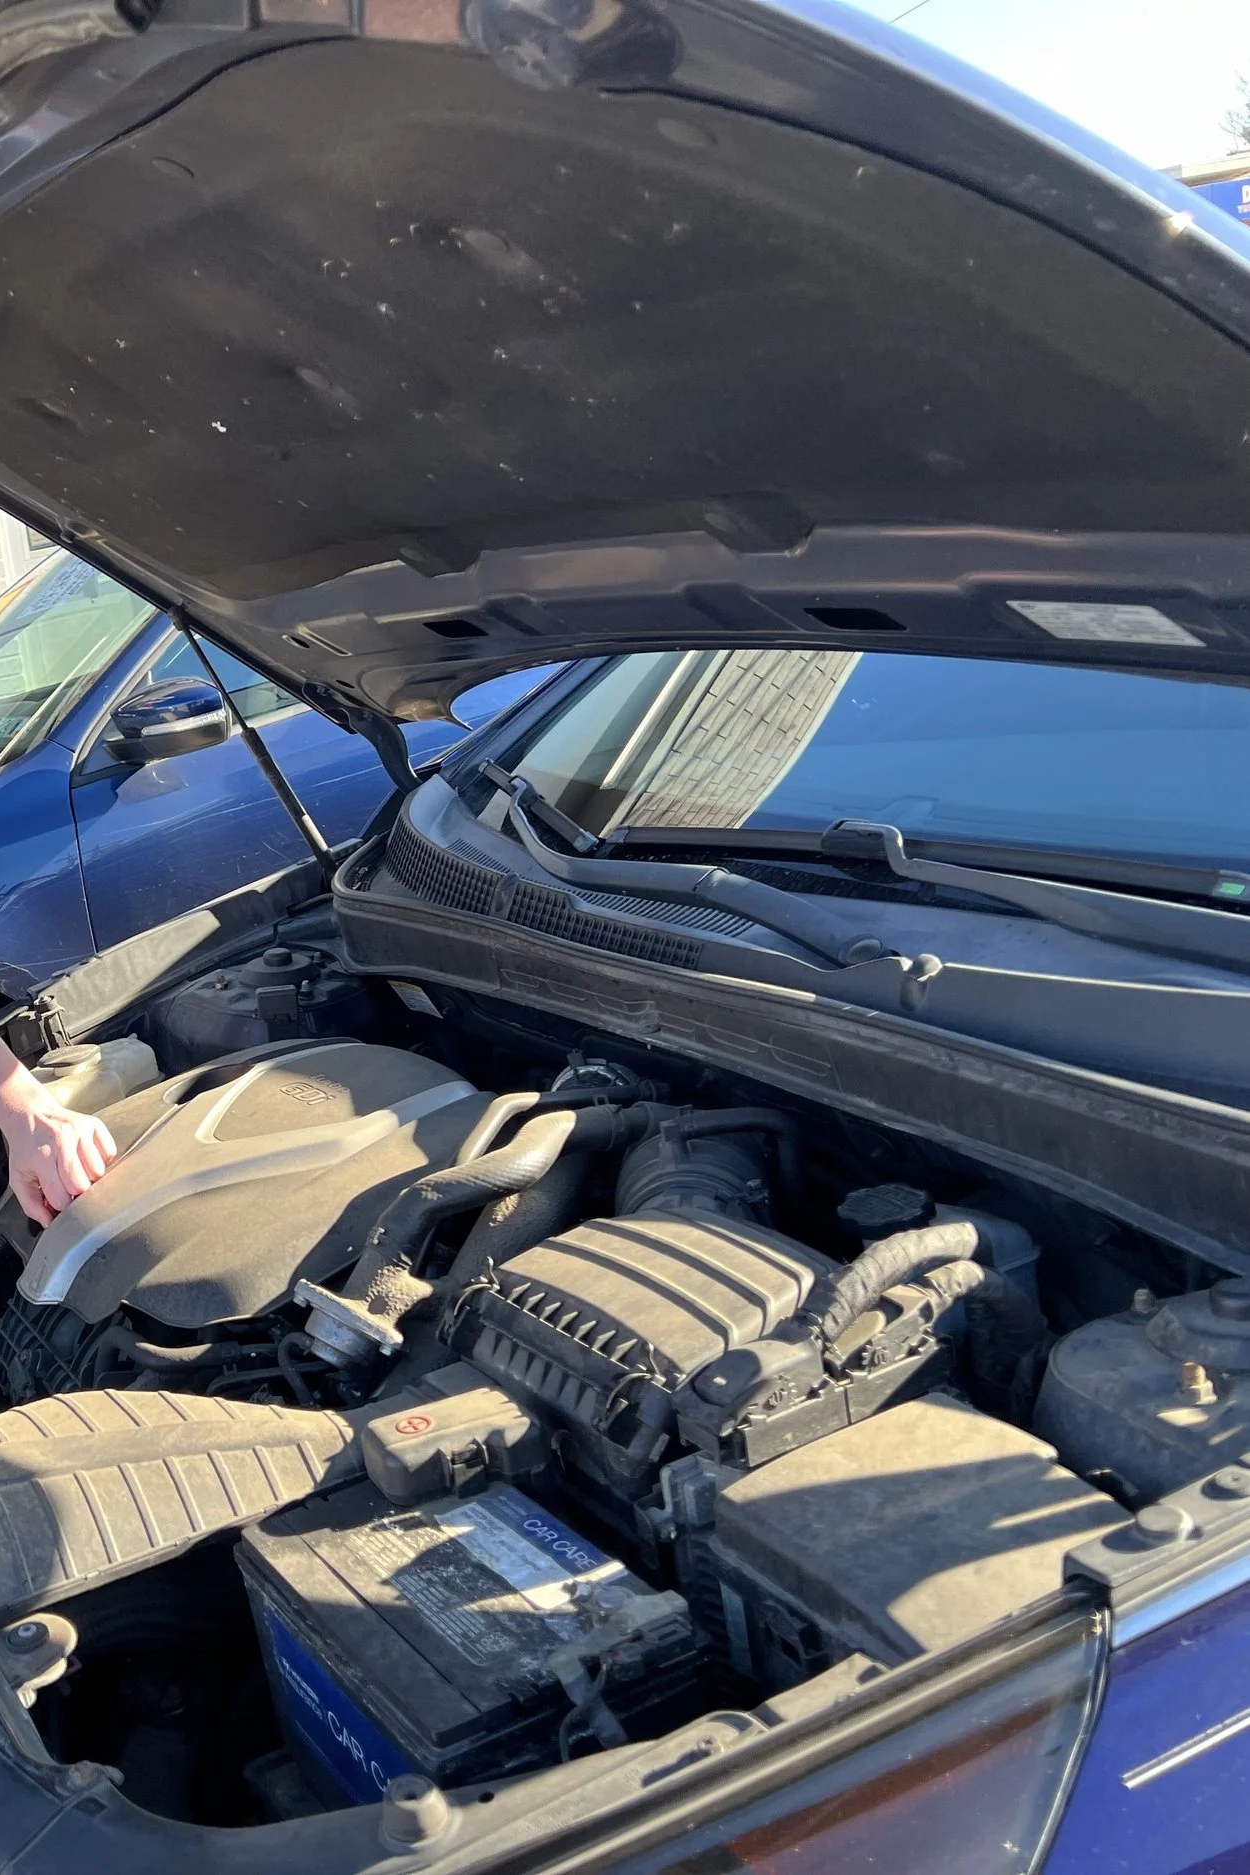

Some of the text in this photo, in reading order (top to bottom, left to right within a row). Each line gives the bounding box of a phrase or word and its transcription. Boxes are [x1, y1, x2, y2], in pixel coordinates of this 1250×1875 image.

[523, 1519, 558, 1543] CAR
[552, 1540, 599, 1570] CARE
[327, 1711, 368, 1773] CAR
